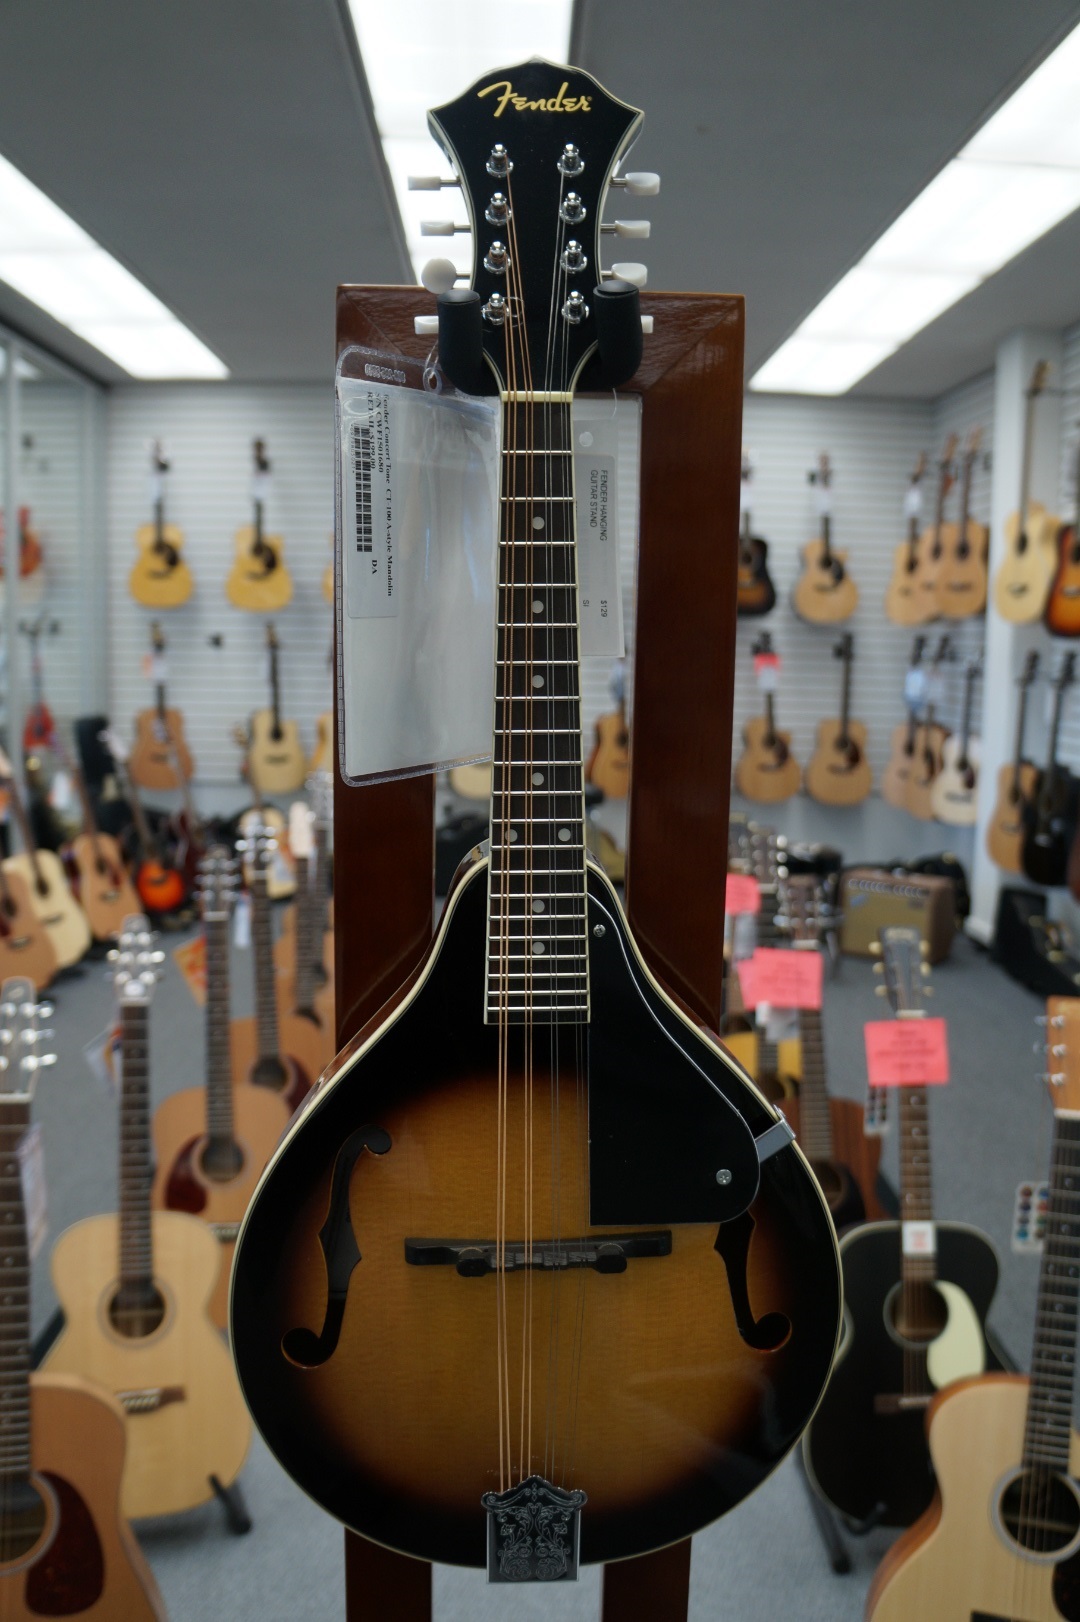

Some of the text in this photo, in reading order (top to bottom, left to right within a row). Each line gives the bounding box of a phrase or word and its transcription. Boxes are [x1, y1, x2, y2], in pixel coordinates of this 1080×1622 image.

[477, 81, 591, 118] Fender
[590, 469, 598, 528] GUITAR STAND
[599, 469, 608, 541] FENDER HANGING
[371, 559, 378, 575] DA
[600, 599, 608, 618] $129
